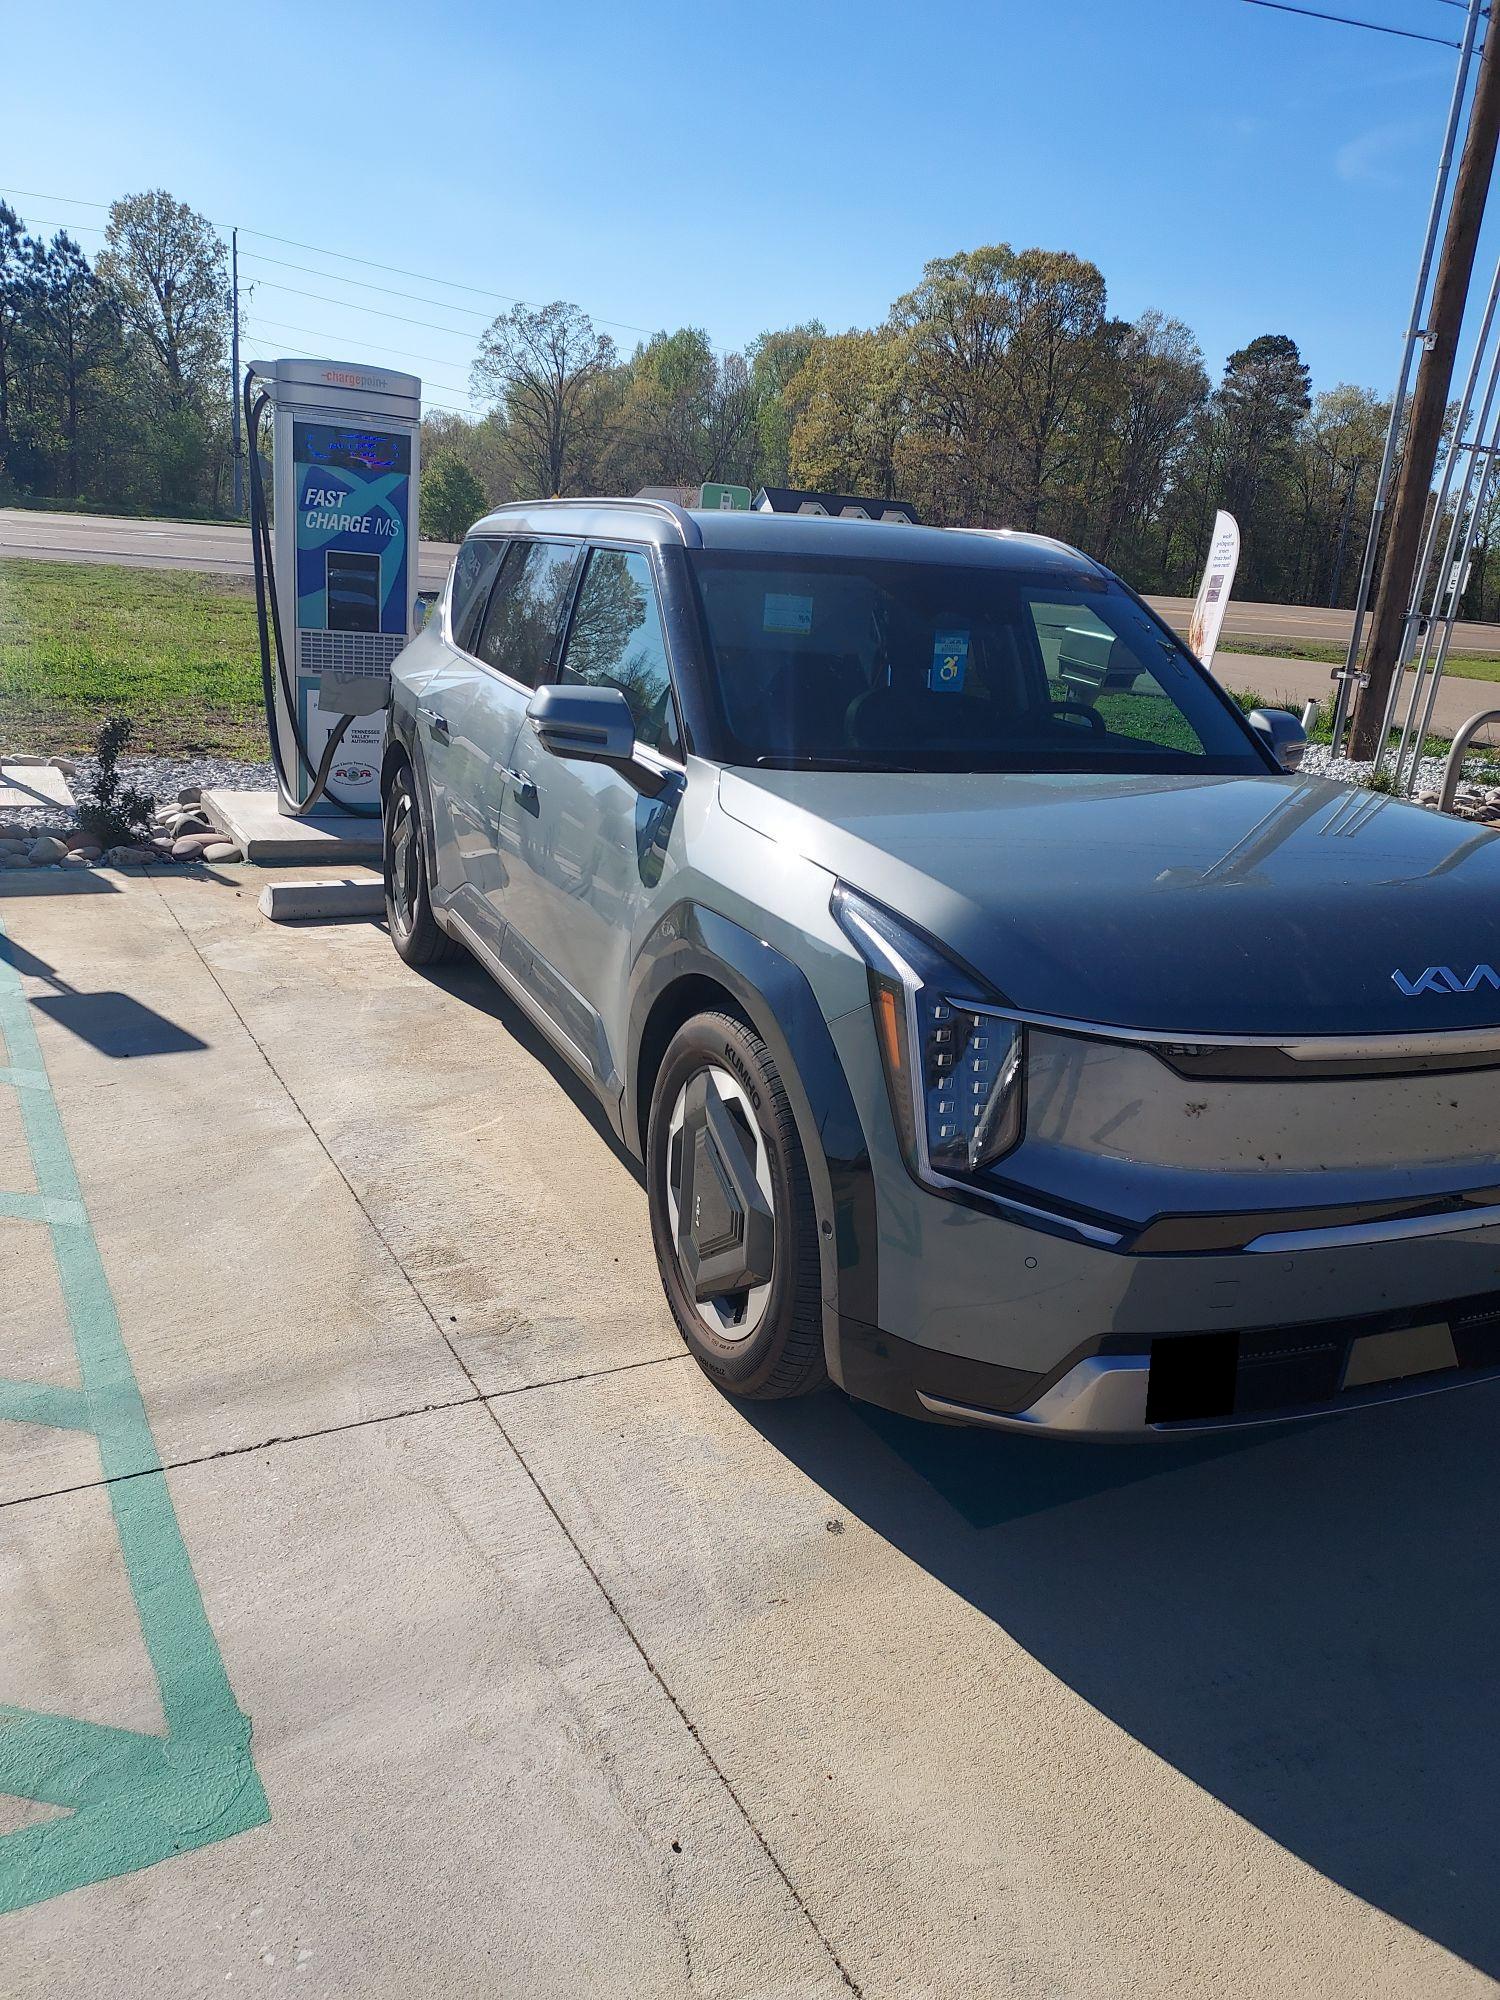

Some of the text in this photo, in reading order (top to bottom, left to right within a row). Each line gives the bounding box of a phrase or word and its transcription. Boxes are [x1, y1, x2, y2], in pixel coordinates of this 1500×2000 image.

[305, 488, 348, 508] FAST
[305, 511, 401, 537] CHARGE MS
[724, 1043, 761, 1112] KUMHO
